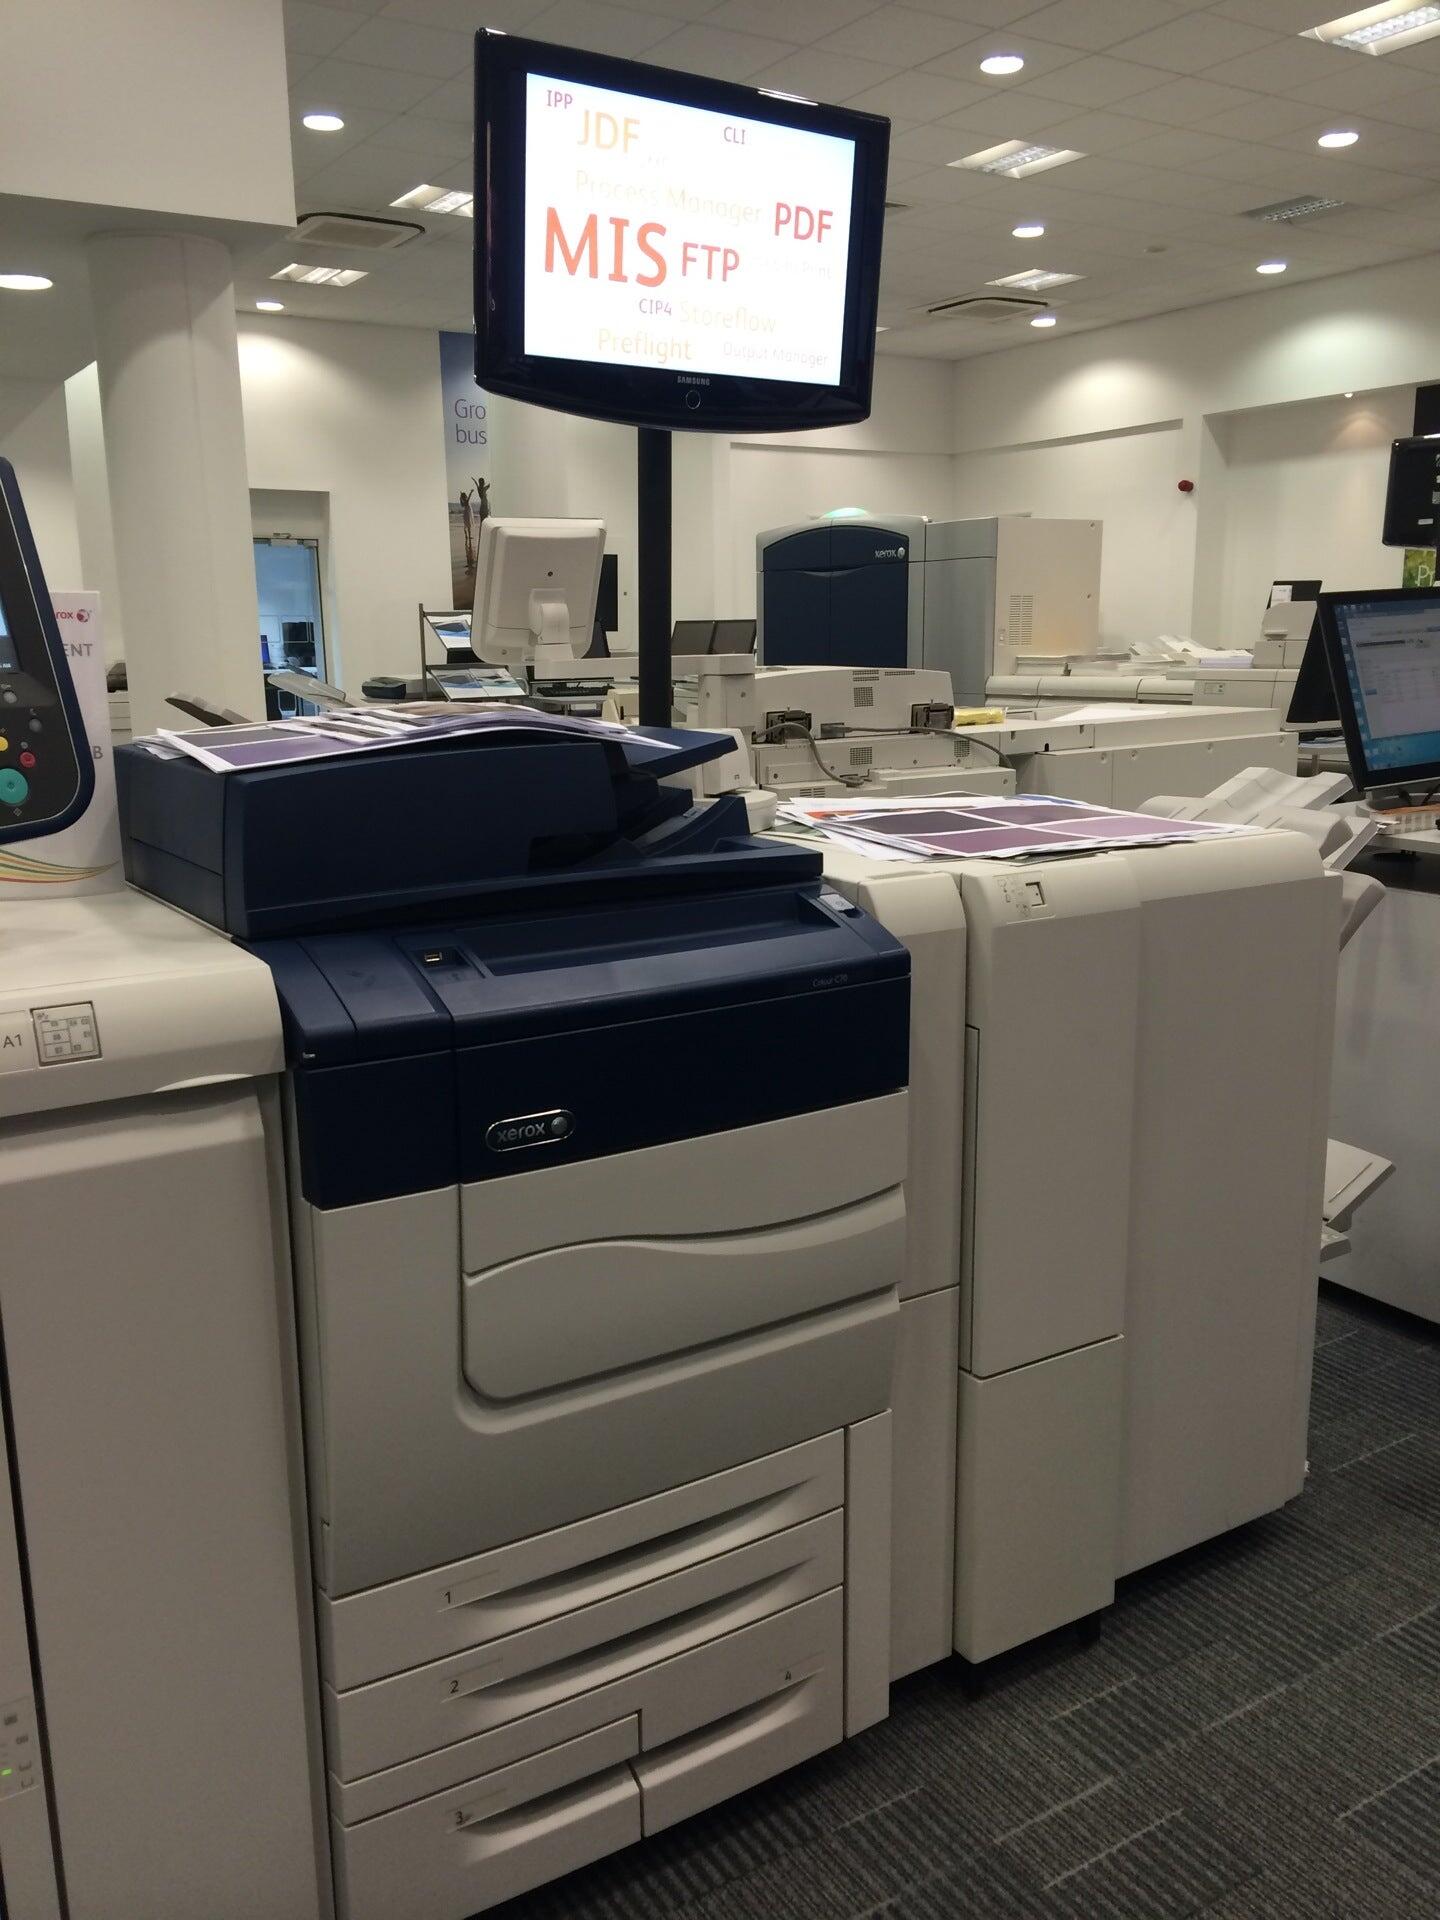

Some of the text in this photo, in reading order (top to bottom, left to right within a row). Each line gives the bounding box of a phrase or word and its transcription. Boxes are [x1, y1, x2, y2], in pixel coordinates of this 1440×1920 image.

[546, 89, 573, 110] IPP
[577, 109, 641, 153] JDF
[723, 126, 747, 145] CLI
[576, 169, 763, 227] Process Manager
[774, 202, 834, 244] PDF
[544, 206, 668, 288] MIS
[681, 242, 740, 282] FTP
[638, 298, 672, 316] CIP4
[680, 301, 777, 333] Storeflow
[598, 328, 693, 364] Preflight
[677, 375, 711, 386] SAMSUNG
[454, 398, 487, 420] Gro
[455, 423, 488, 445] bus
[55, 611, 74, 620] rox
[3, 1034, 22, 1048] A1
[497, 1122, 546, 1144] xerox
[444, 1591, 452, 1604] 1
[450, 1679, 460, 1693] 2
